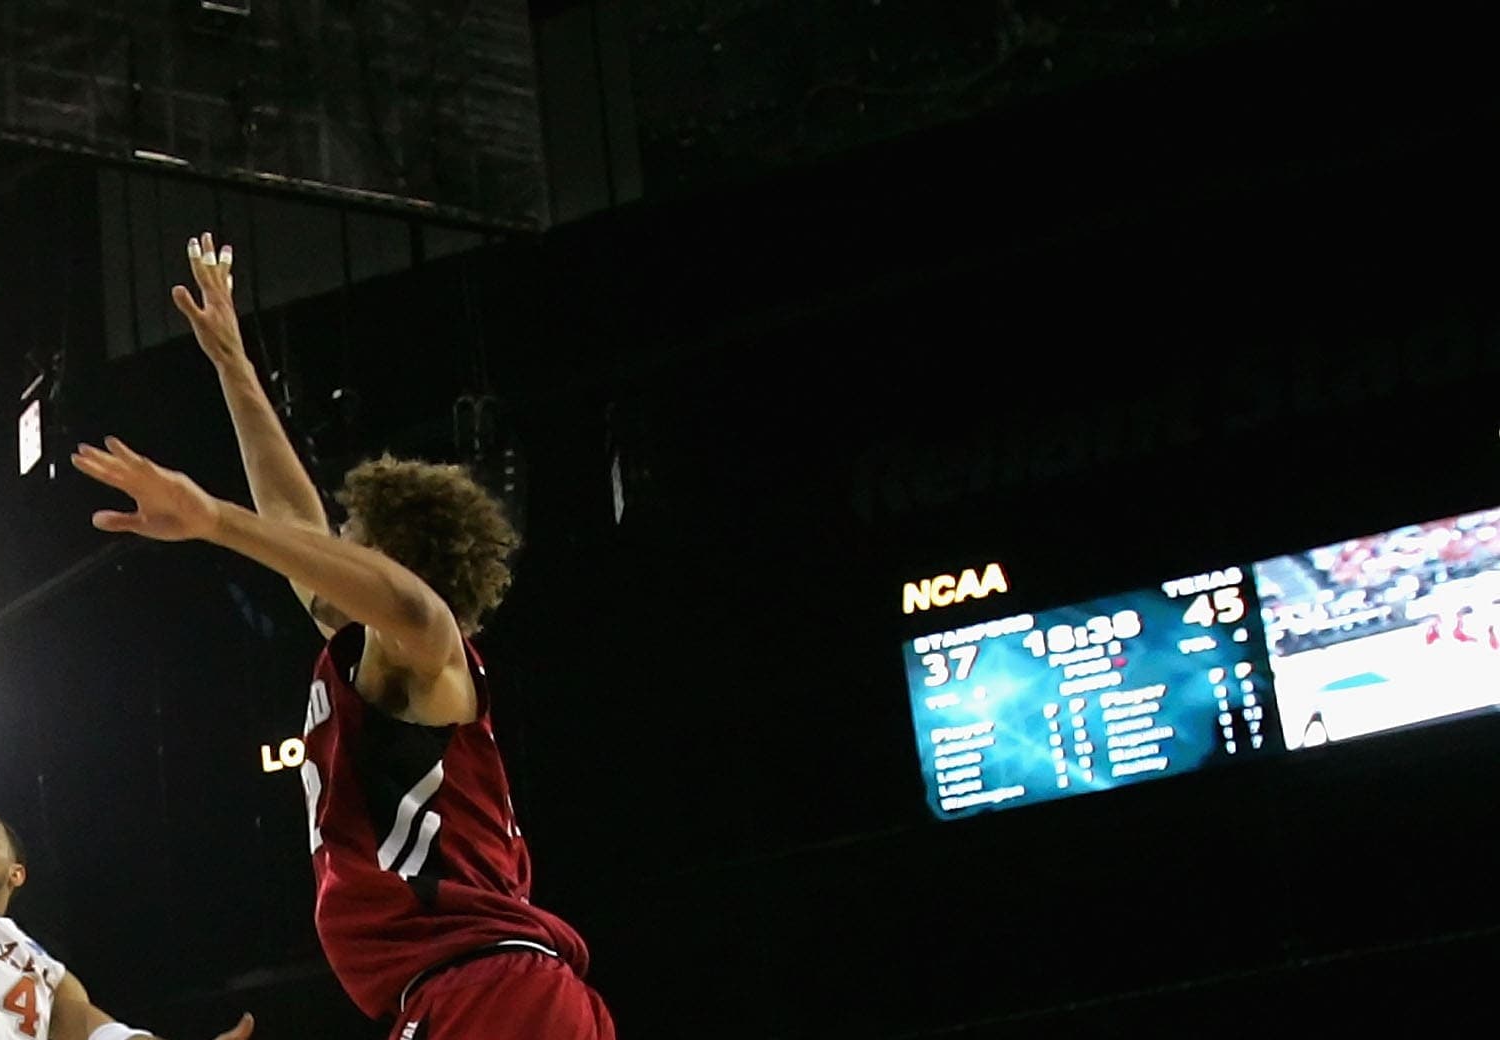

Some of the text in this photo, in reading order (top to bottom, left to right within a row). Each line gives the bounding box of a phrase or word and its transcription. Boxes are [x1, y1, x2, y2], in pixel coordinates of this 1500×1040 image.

[903, 563, 1008, 614] NCAA
[1182, 587, 1247, 627] 45
[922, 645, 978, 687] 37
